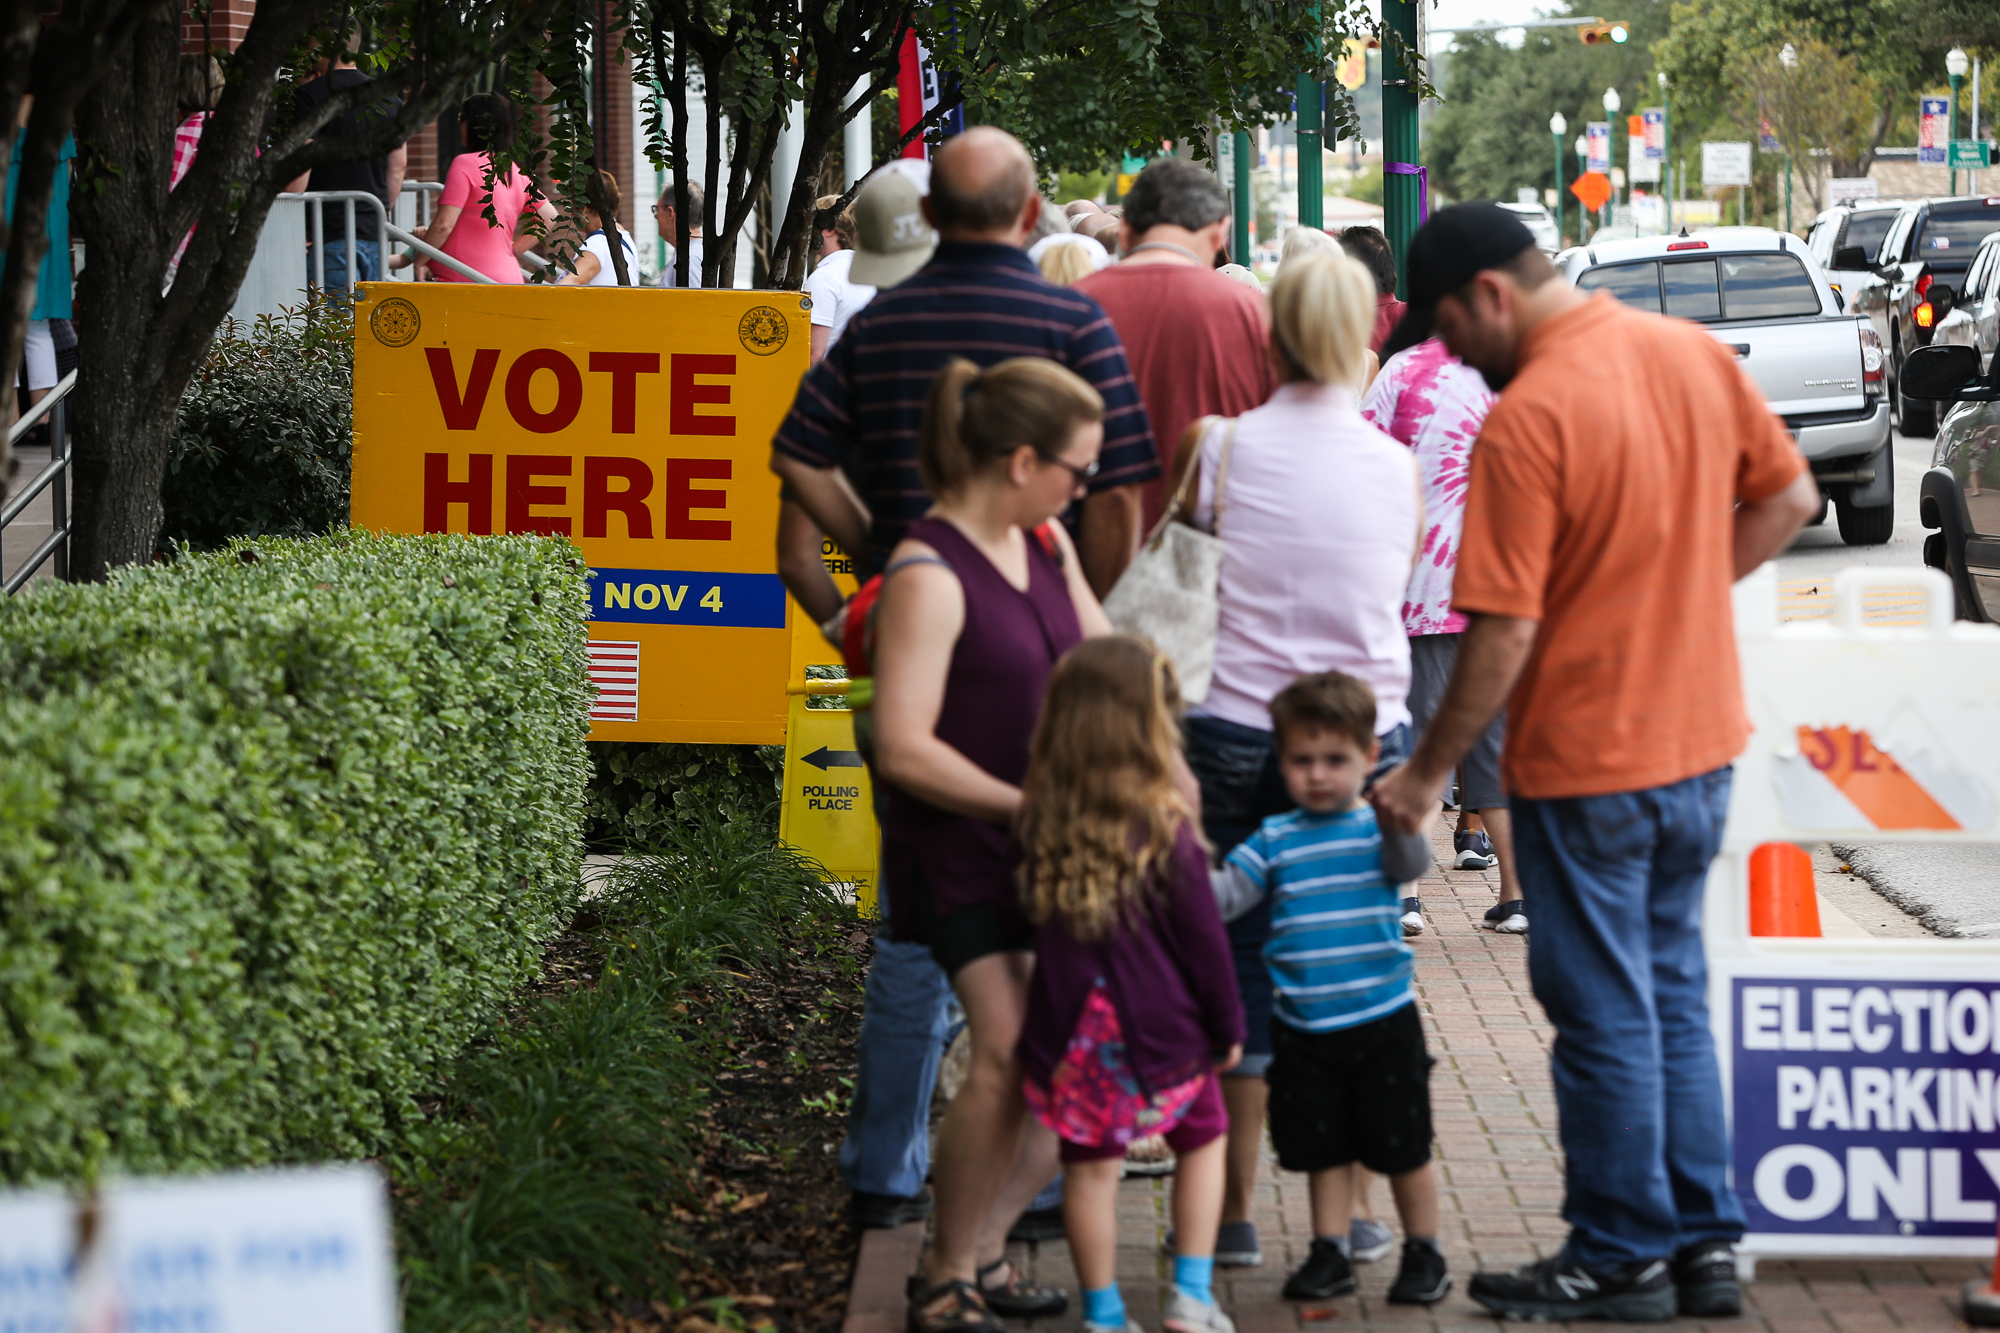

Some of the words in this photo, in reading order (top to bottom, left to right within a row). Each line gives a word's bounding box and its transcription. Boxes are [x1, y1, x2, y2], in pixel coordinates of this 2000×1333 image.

[777, 319, 786, 345] TEXAS
[424, 347, 736, 436] VOTE
[423, 453, 732, 541] HERE
[822, 559, 853, 574] ERE
[604, 582, 689, 612] NOV
[699, 585, 724, 613] 4
[802, 785, 859, 798] POLLING
[808, 798, 853, 811] PLACE
[1742, 985, 2000, 1055] ELECTIO
[1776, 1064, 2000, 1133] PARKIN
